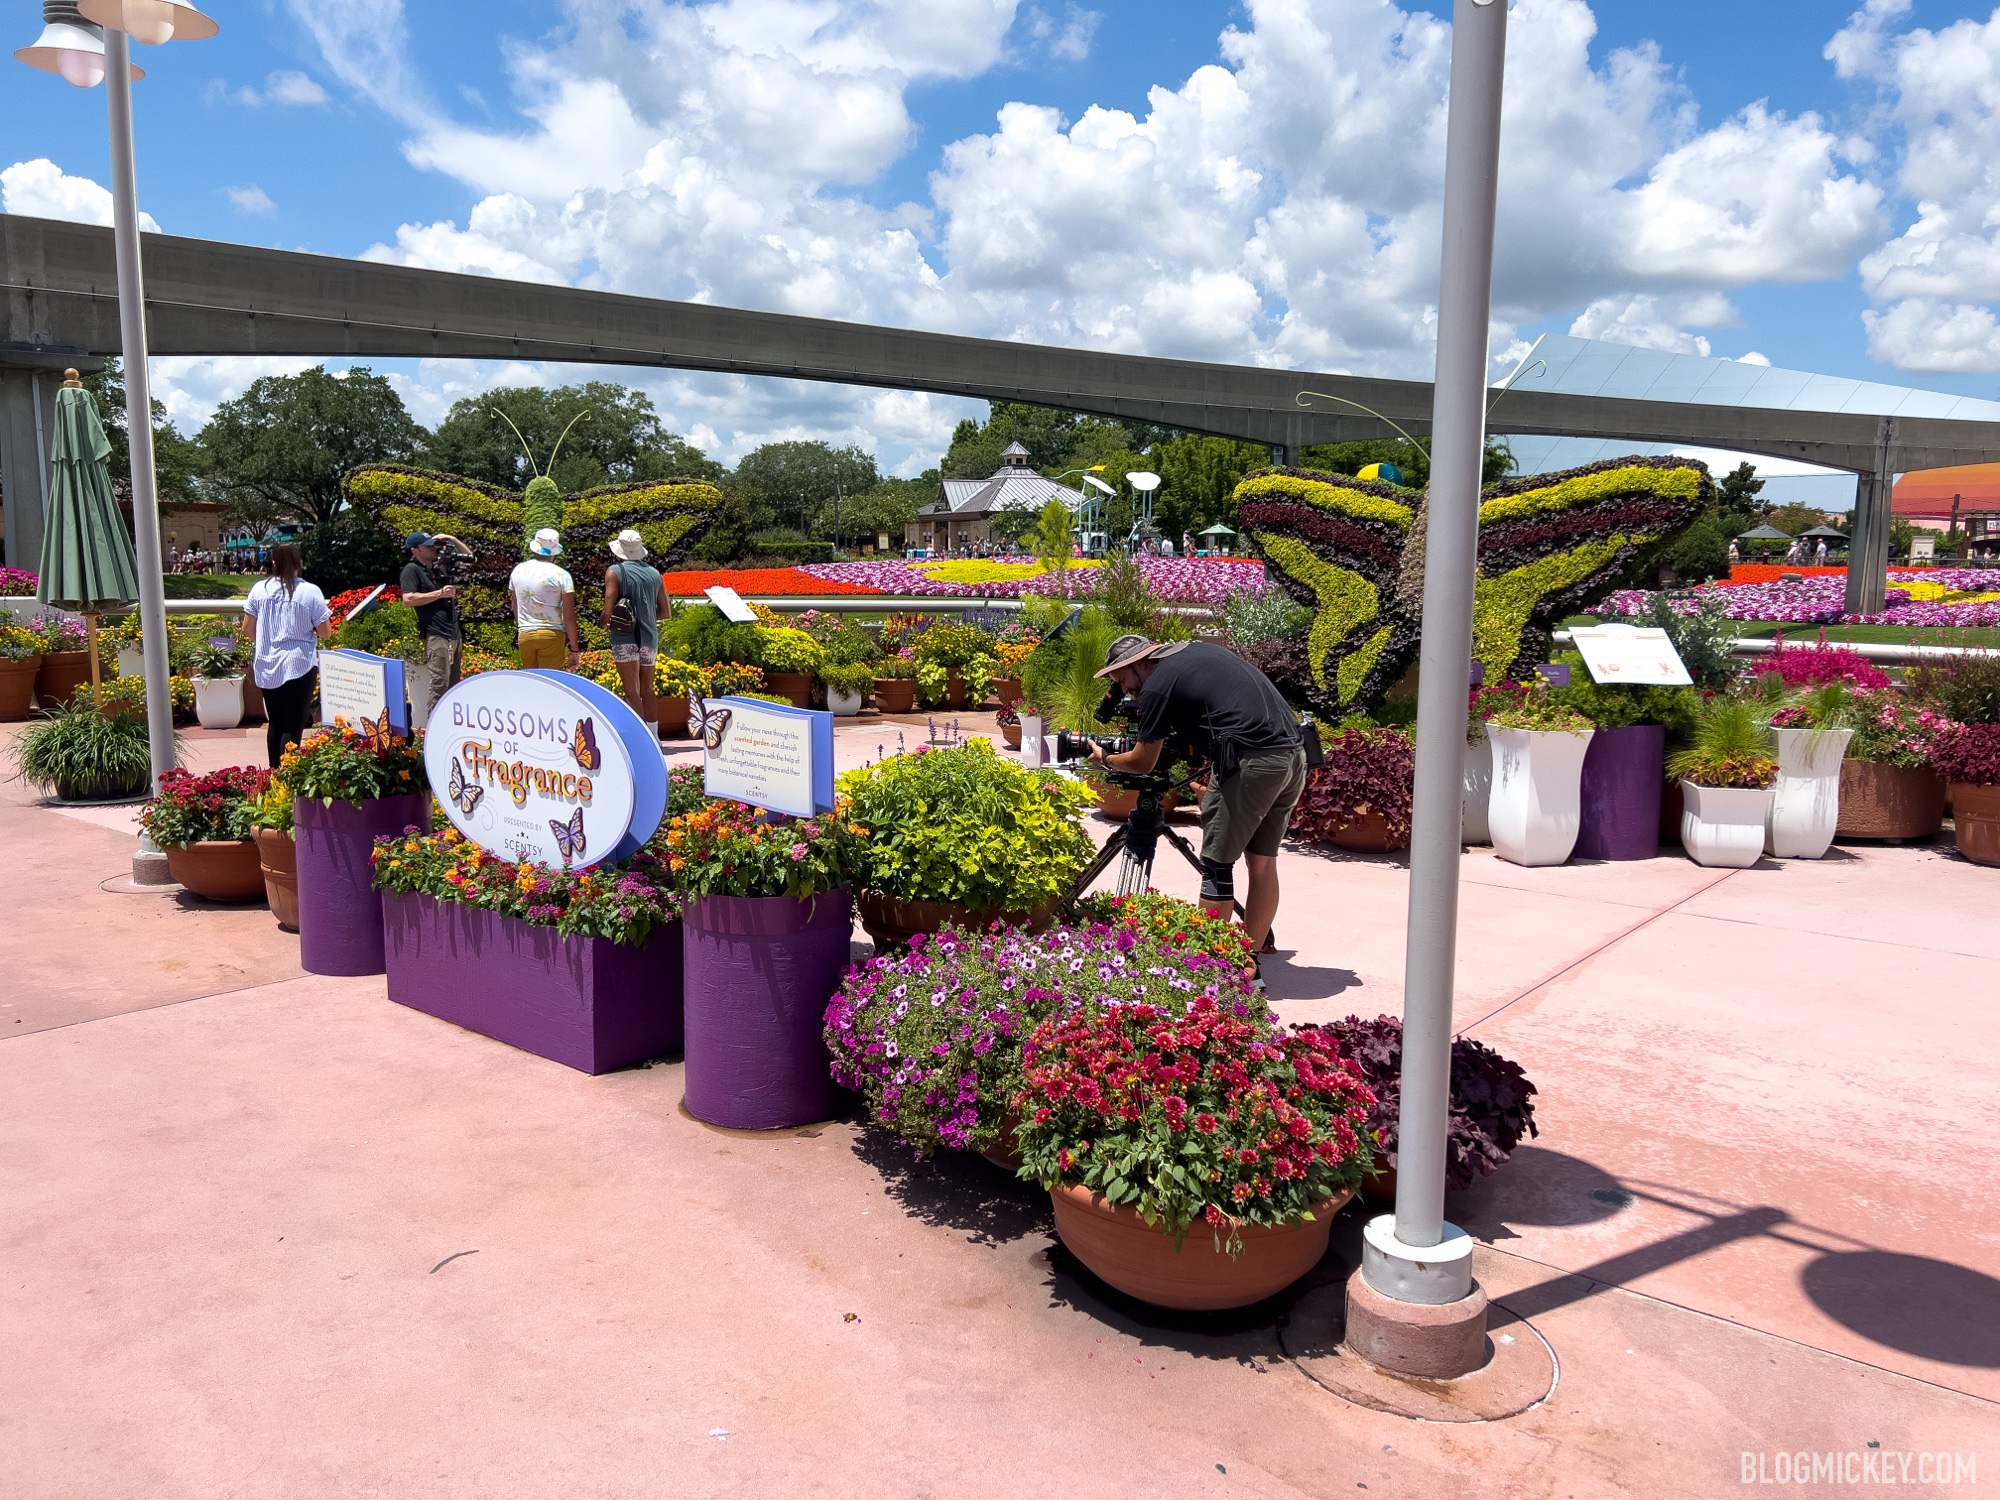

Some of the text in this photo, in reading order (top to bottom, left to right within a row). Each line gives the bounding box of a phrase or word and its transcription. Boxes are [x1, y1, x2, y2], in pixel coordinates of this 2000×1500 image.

[453, 702, 568, 744] BLOSSOMS
[736, 722, 750, 732] Follow
[773, 728, 790, 740] through
[790, 731, 799, 740] this
[504, 740, 518, 756] OF
[734, 736, 752, 744] scented
[753, 738, 769, 747] garden
[780, 742, 797, 751] cherish
[731, 744, 744, 756] lasting
[745, 750, 766, 759] memories
[766, 752, 776, 760] with
[785, 754, 794, 765] help
[462, 738, 592, 803] Fragrance
[729, 766, 749, 778] botanical
[781, 766, 789, 774] and
[746, 790, 768, 799] SCENTSY
[504, 816, 534, 830] PRESENTED
[504, 838, 542, 856] SCENTSY
